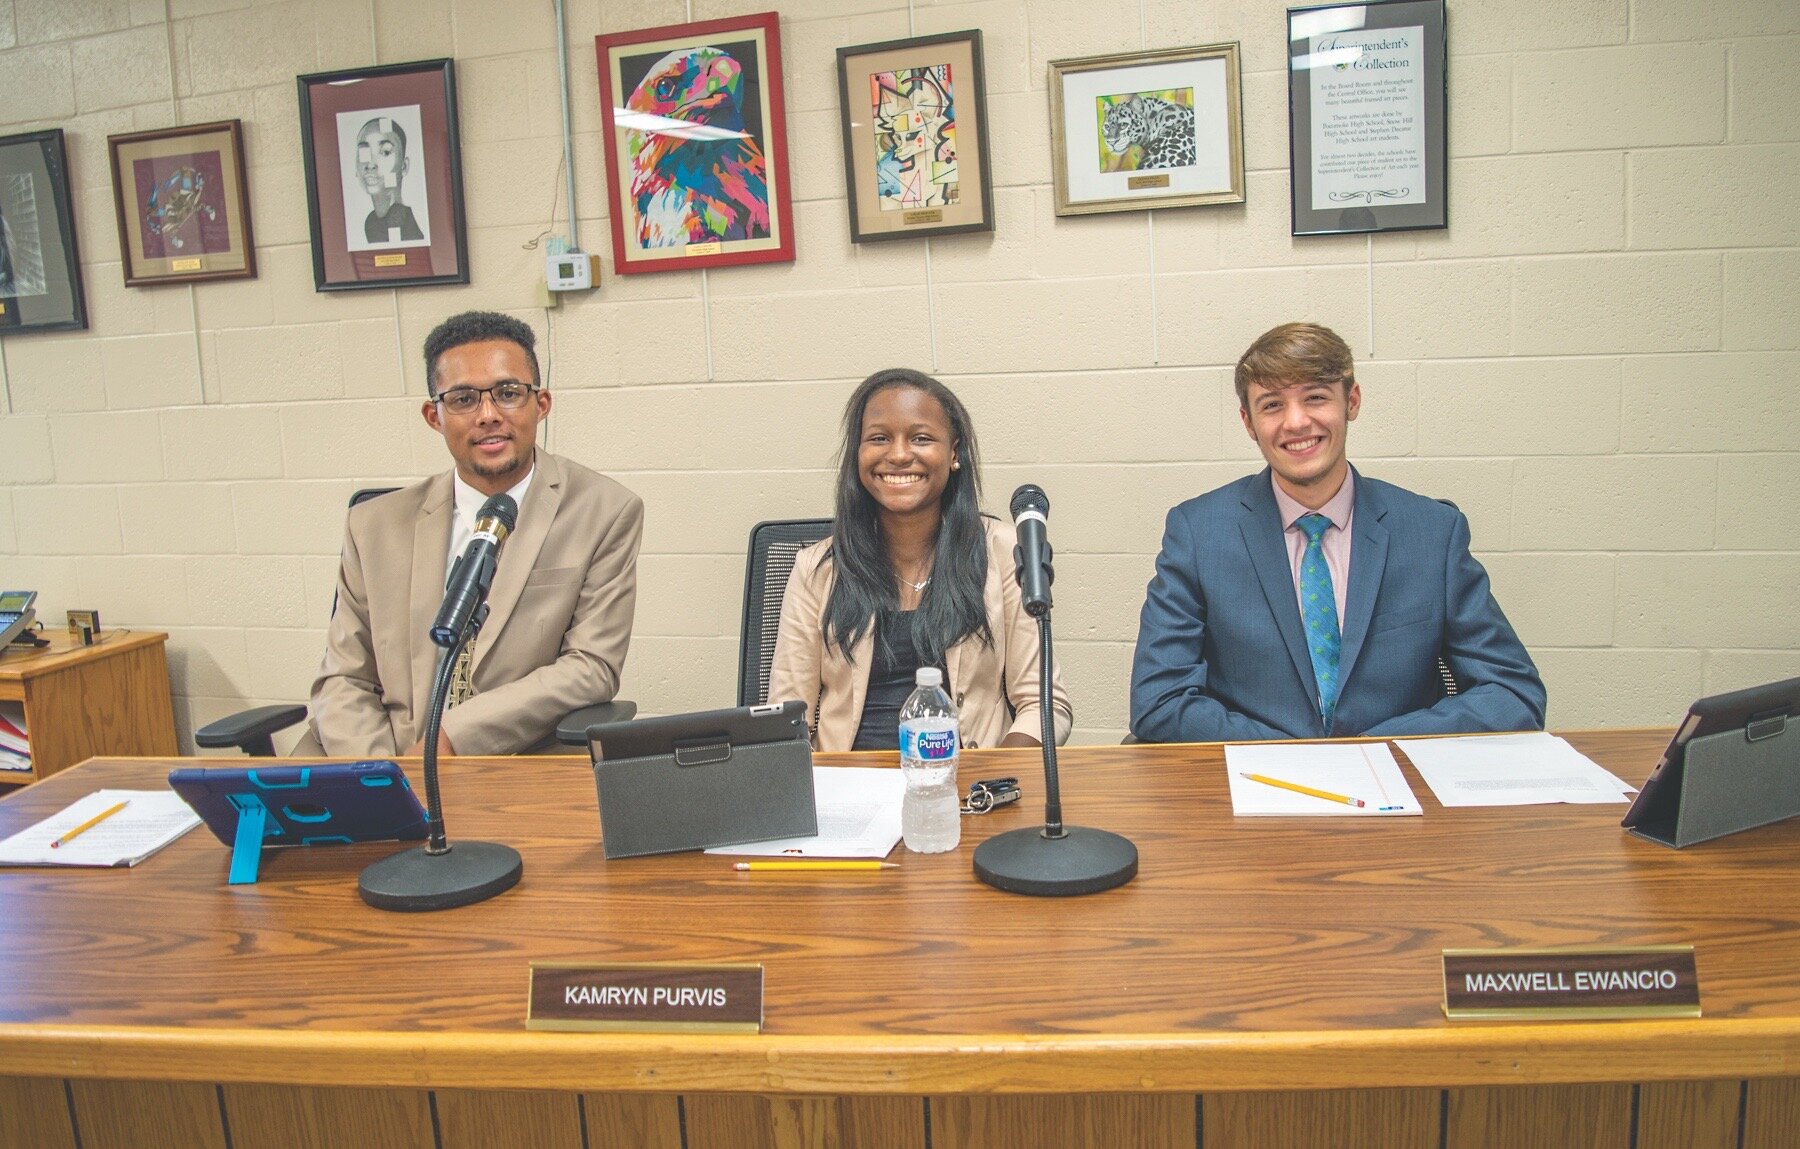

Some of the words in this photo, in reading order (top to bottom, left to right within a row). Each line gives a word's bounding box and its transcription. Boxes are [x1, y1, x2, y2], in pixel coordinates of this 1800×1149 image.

[1318, 36, 1408, 53] Sintendent's
[1353, 54, 1409, 71] Collection
[920, 739, 940, 749] Pure
[942, 738, 954, 751] Life
[1465, 972, 1570, 992] MAXWELL
[1574, 970, 1677, 990] EWANCIO
[565, 986, 648, 1005] KAMRYN
[653, 988, 726, 1006] PURVIS
